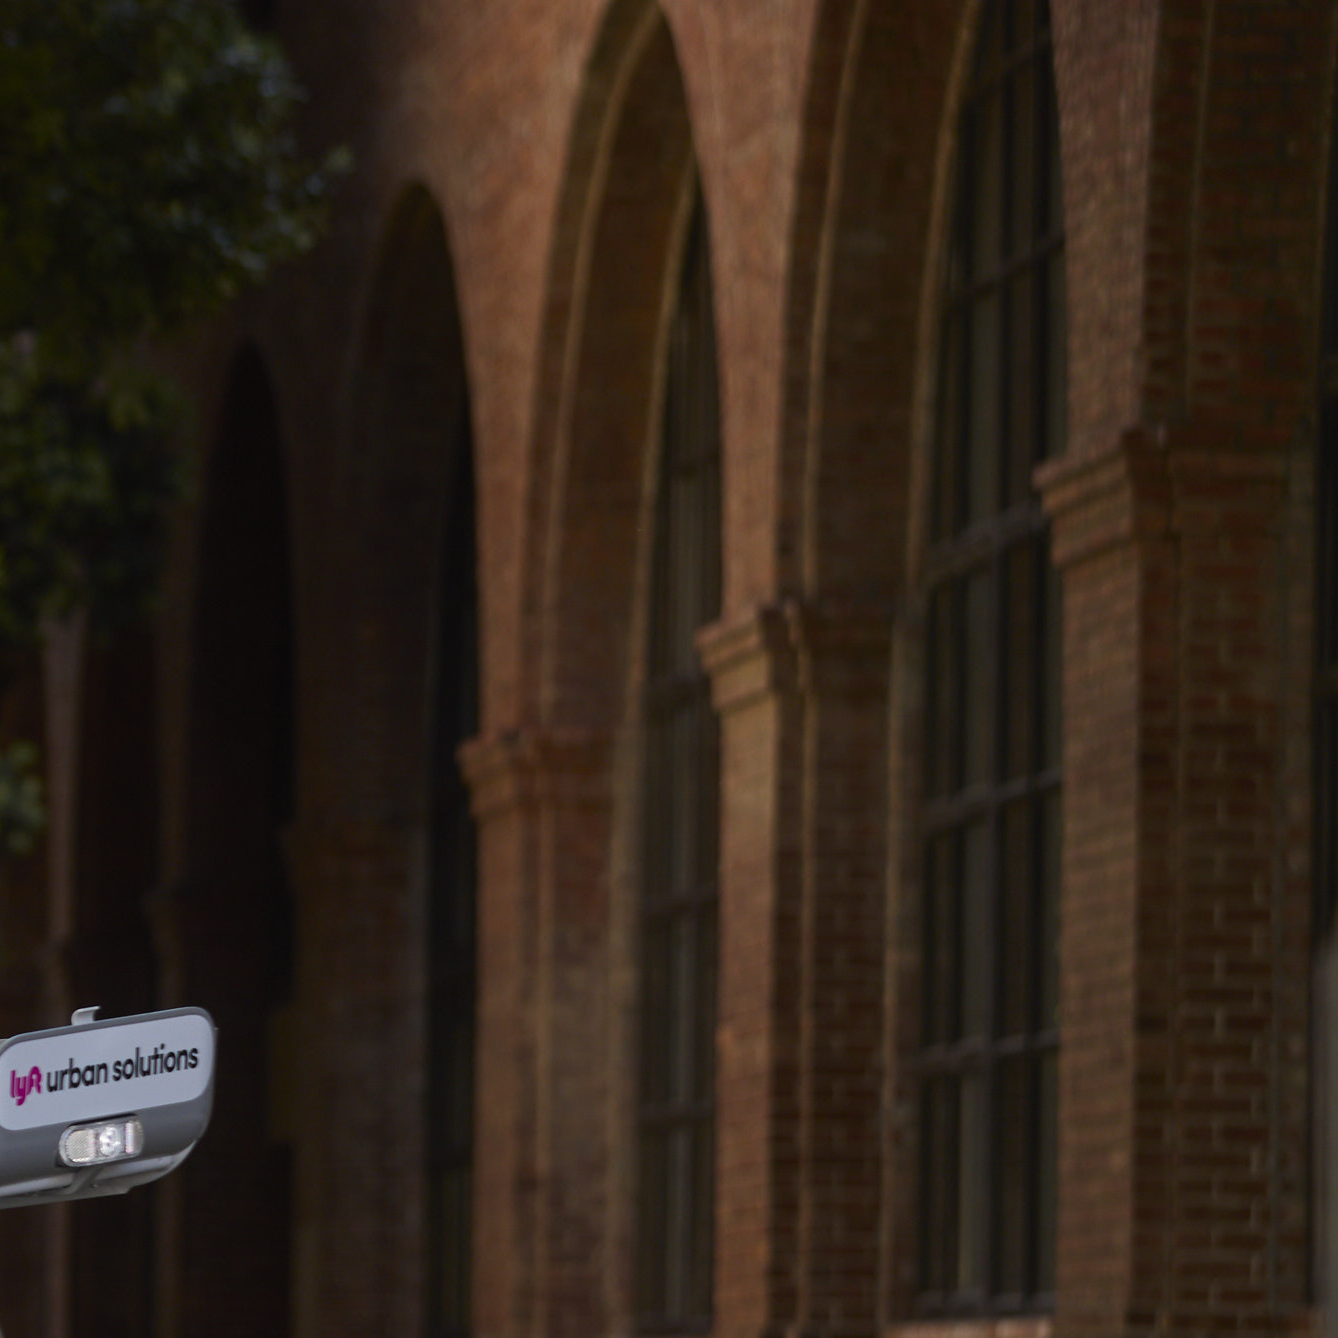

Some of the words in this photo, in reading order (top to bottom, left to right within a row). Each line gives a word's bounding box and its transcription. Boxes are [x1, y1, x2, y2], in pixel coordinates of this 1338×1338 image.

[10, 1066, 42, 1106] lyft
[47, 1058, 108, 1092] urban
[113, 1044, 198, 1081] solutions
